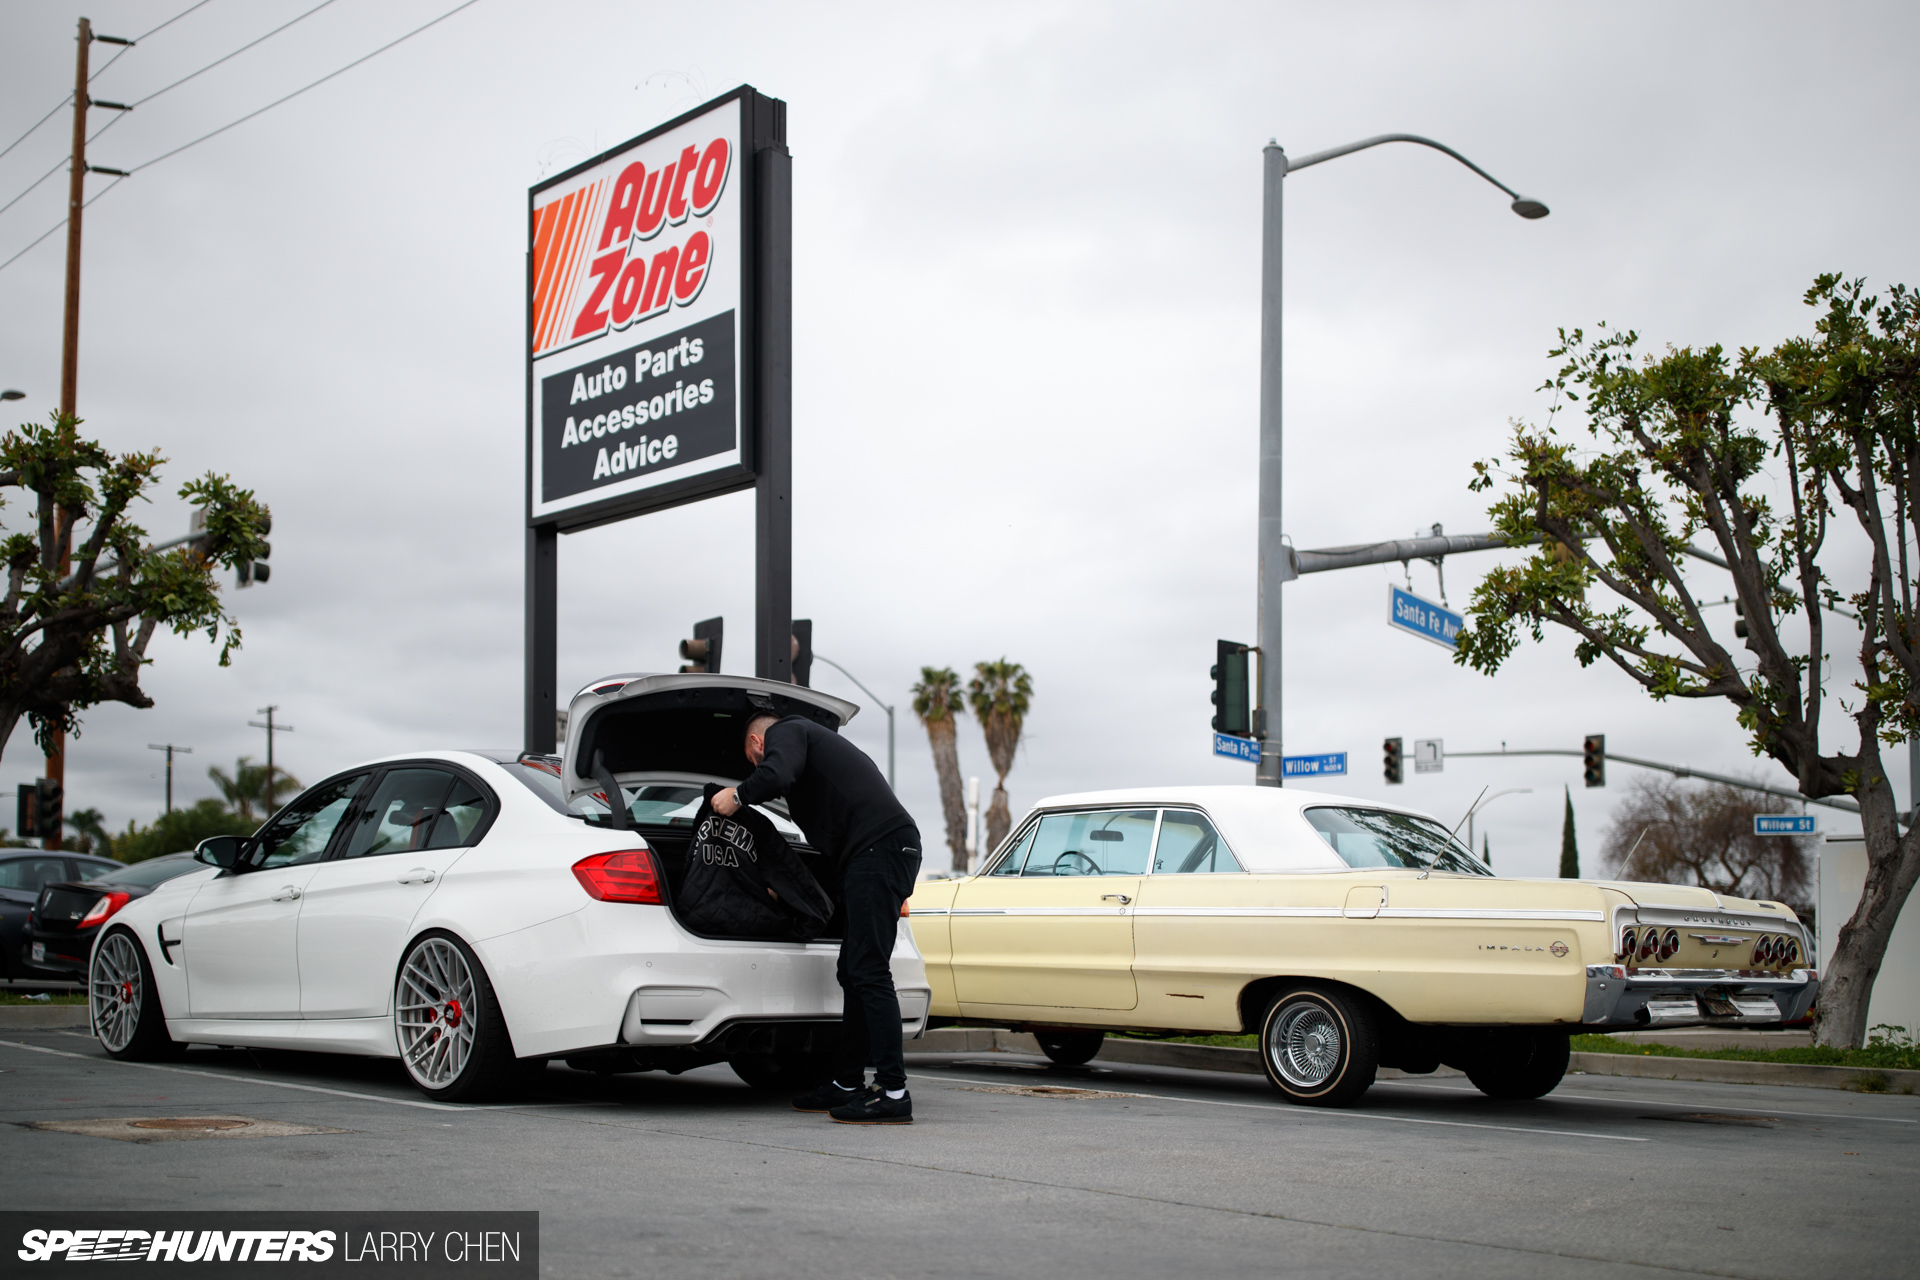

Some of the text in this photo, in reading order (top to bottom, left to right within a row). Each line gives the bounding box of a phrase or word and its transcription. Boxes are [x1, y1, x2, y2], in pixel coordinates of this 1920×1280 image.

[597, 137, 729, 252] Auto
[570, 230, 709, 340] Zone
[569, 336, 704, 404] Auto Parts
[560, 377, 714, 448] Accessories
[593, 434, 678, 480] Advice
[1396, 597, 1426, 627] Santa
[1429, 610, 1440, 633] Fe
[1217, 737, 1250, 757] Santa Fe
[1285, 759, 1320, 774] Willow
[1760, 818, 1811, 831] Willow St
[703, 844, 739, 867] USA
[1478, 944, 1544, 952] IMPALA
